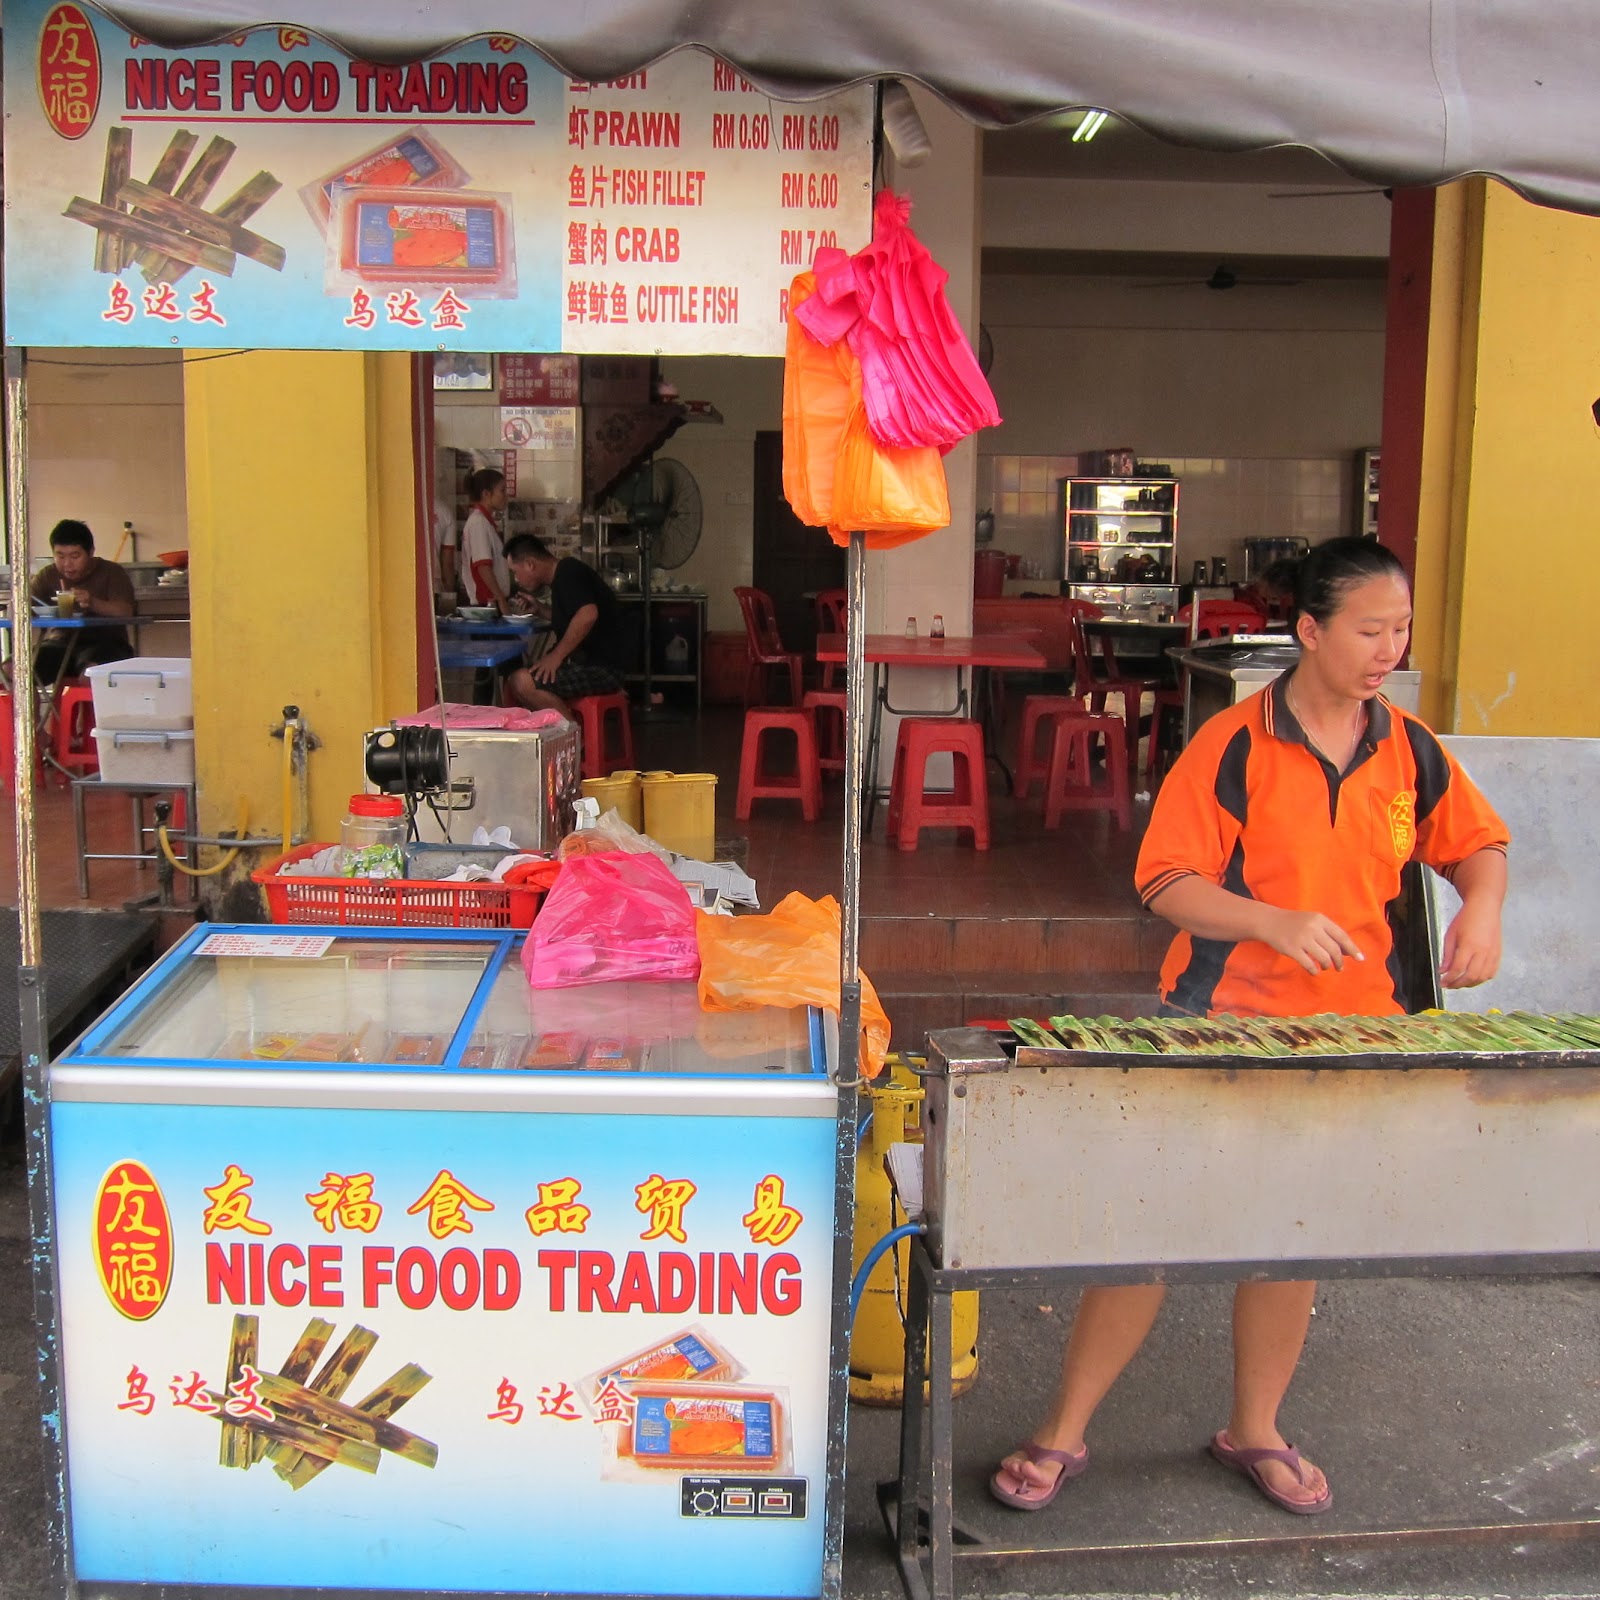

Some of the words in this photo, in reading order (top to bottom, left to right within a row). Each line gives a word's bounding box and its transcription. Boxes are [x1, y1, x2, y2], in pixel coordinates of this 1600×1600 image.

[47, 10, 91, 124] 友福
[125, 59, 221, 111] NICE
[231, 60, 340, 112] FOOD
[348, 61, 528, 114] TRADING
[568, 105, 589, 150] 虾
[594, 111, 680, 148] PRAWN
[713, 113, 735, 149] RM
[739, 113, 770, 150] 0.60
[783, 115, 805, 150] RM
[809, 115, 839, 151] 6.00
[568, 164, 608, 208] 鱼片
[612, 169, 648, 205] FISH
[653, 171, 706, 206] FILLET
[781, 173, 803, 208] RM
[807, 173, 838, 209] 6.00
[568, 221, 608, 266] 蟹肉
[615, 227, 680, 263] CRAB
[780, 230, 802, 265] RM
[102, 282, 227, 327] 乌达支
[344, 288, 471, 330] 乌达盒
[567, 281, 629, 324] 鲜鱿鱼
[636, 284, 697, 323] CUTTLE
[702, 286, 739, 324] FISH
[203, 1164, 803, 1246] 友福食品贸易
[105, 1170, 161, 1302] 友福
[205, 1242, 344, 1307] NICE
[362, 1246, 521, 1311] FOOD
[538, 1250, 802, 1316] TRADING
[117, 1364, 274, 1421] 乌达支
[487, 1376, 637, 1425] 乌达盒
